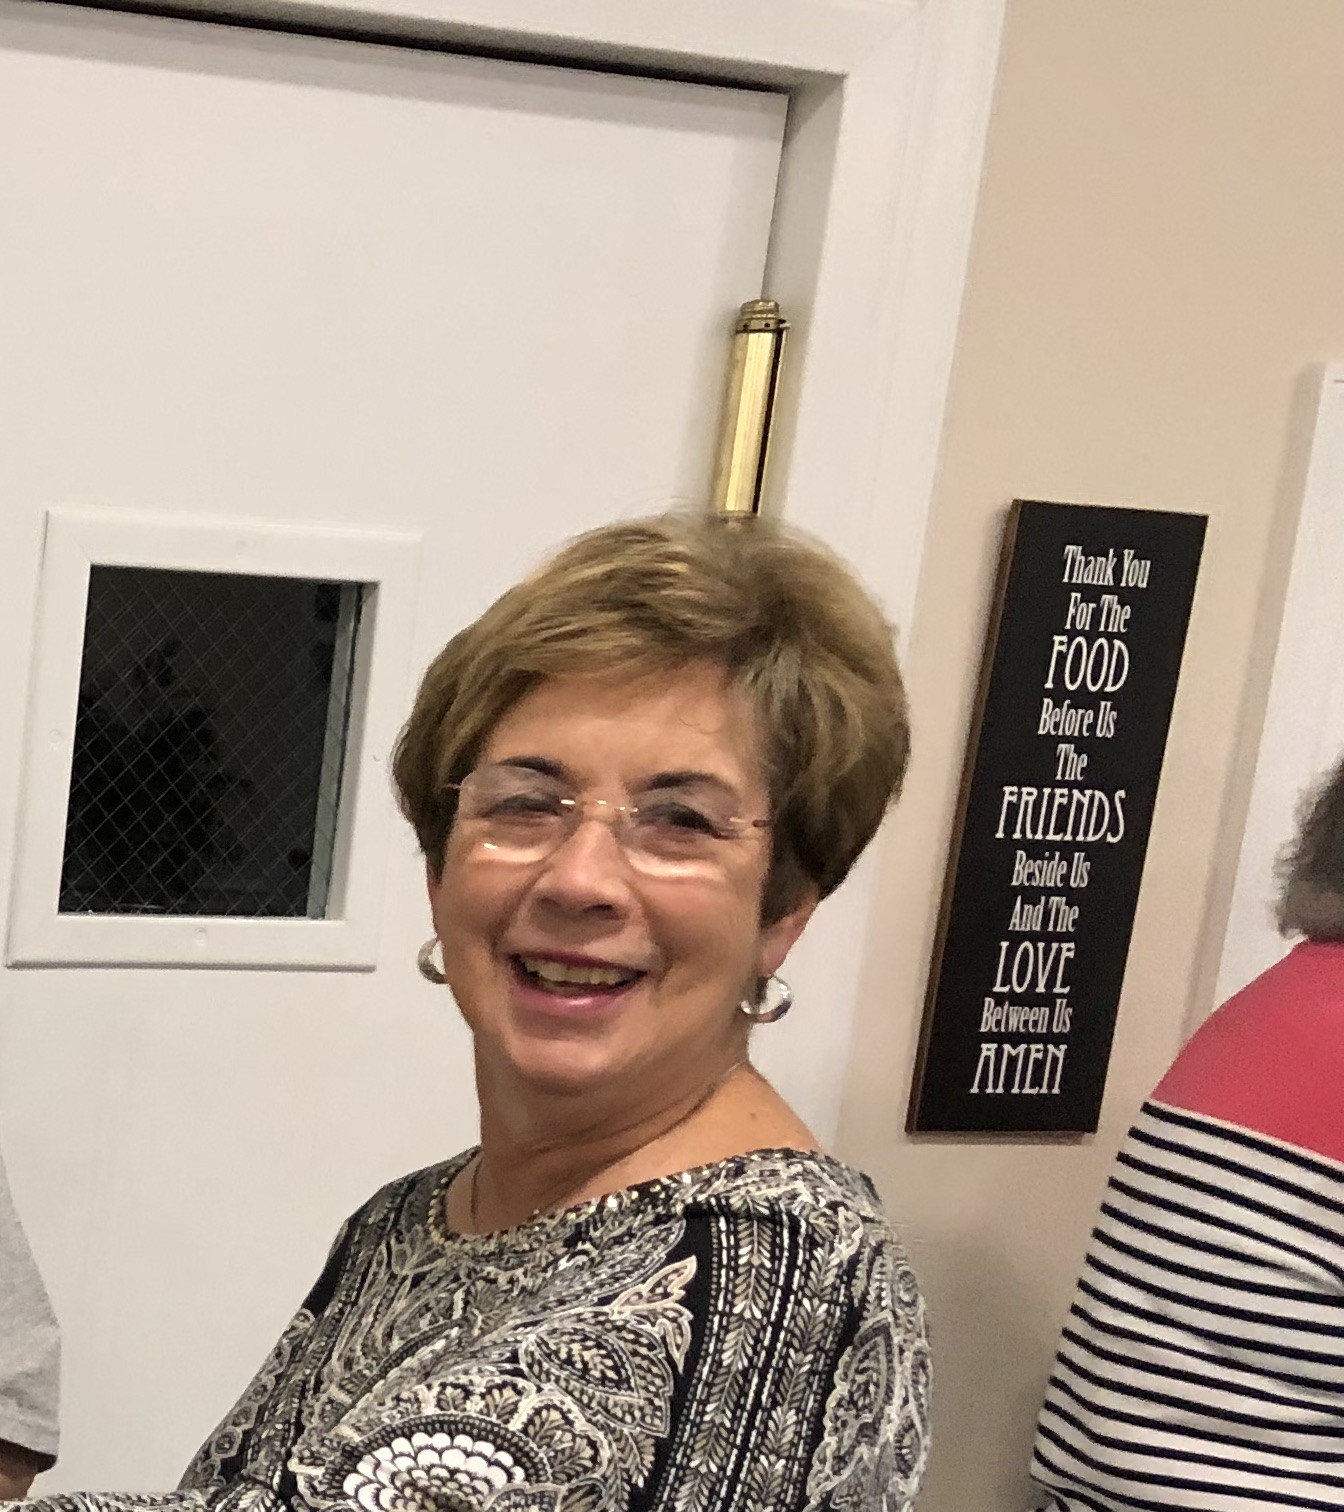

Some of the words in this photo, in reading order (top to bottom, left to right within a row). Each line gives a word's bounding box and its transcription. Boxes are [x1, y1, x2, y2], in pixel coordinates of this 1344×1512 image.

[1062, 544, 1117, 586] Thank
[1119, 548, 1151, 589] You
[1064, 592, 1097, 631] For
[1098, 594, 1132, 633] The
[1044, 635, 1130, 693] FOOD
[1037, 697, 1094, 737] Before
[1095, 701, 1118, 738] Us
[1055, 743, 1089, 781] The
[994, 785, 1127, 844] FRIENDS
[1011, 849, 1068, 888] Beside
[1069, 851, 1091, 888] Us
[1008, 894, 1046, 932] And
[1047, 896, 1080, 933] The
[992, 940, 1076, 994] LOVE
[979, 997, 1050, 1034] Between
[1052, 998, 1074, 1034] Us
[969, 1043, 1068, 1095] AMEN
